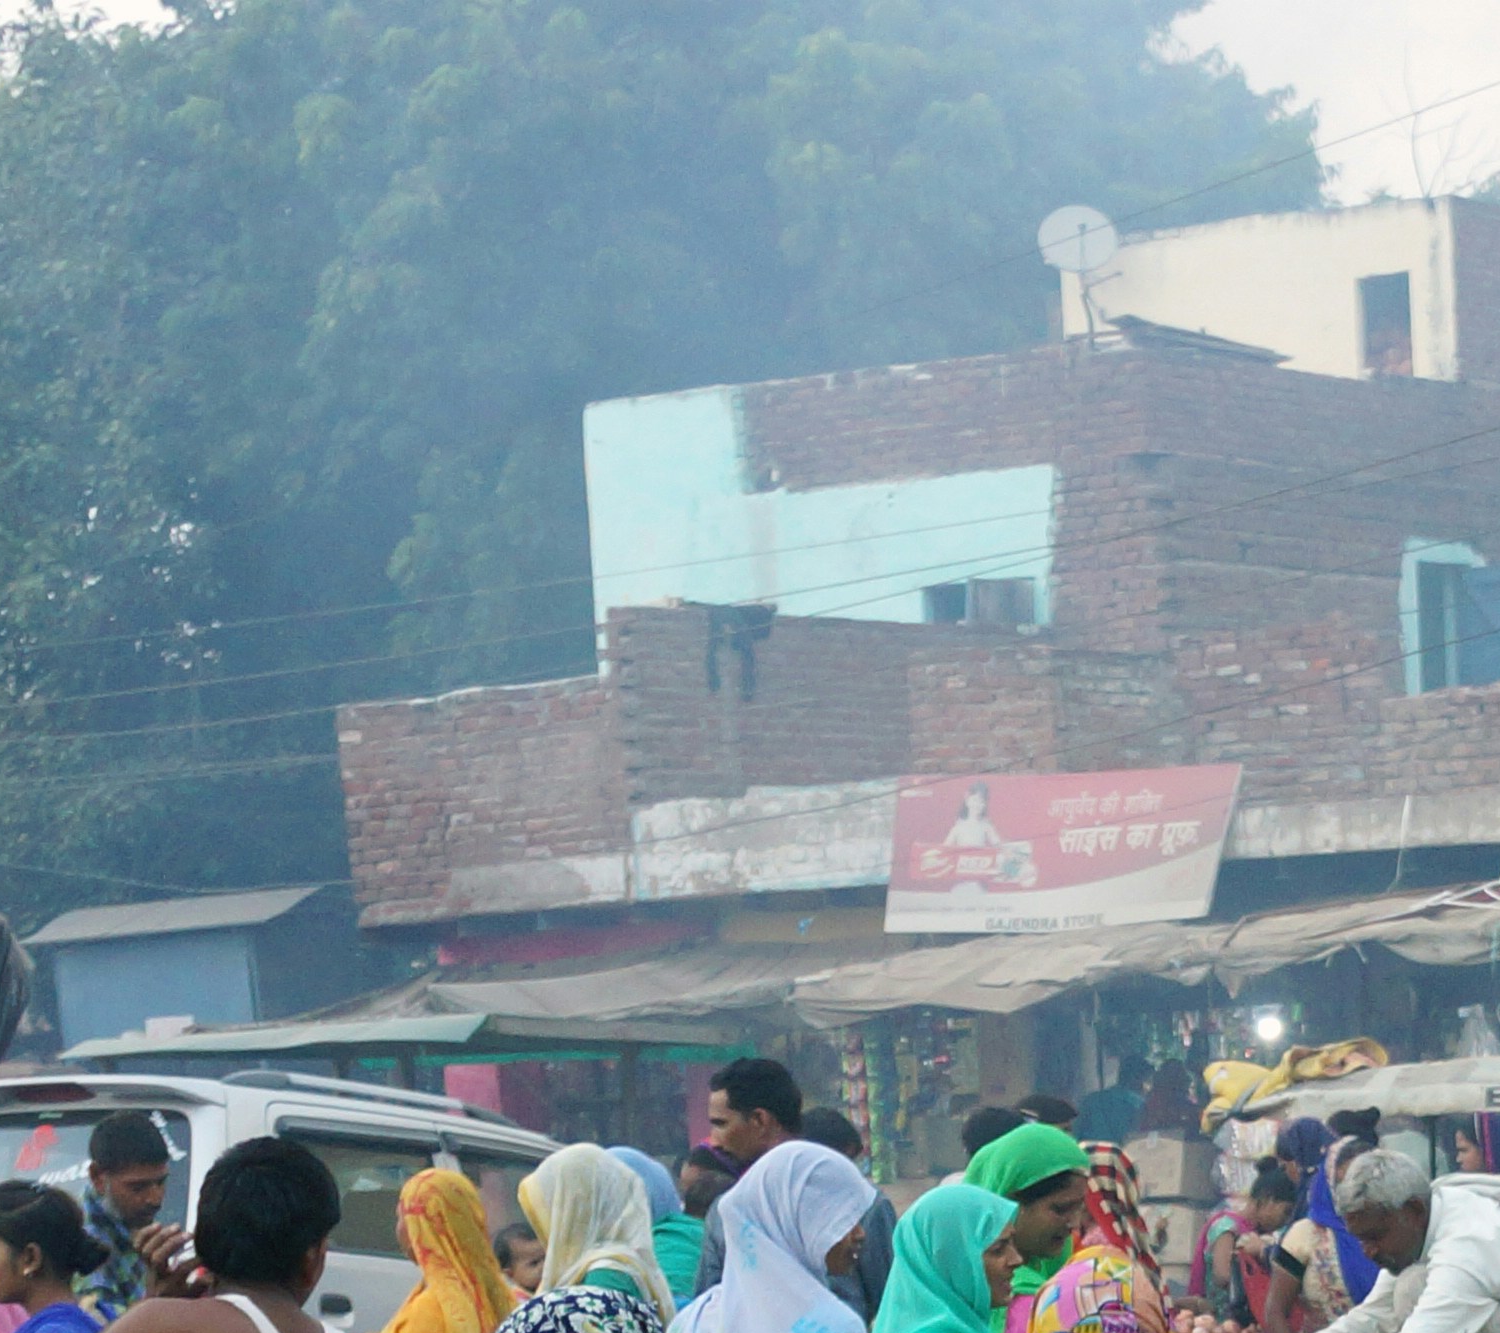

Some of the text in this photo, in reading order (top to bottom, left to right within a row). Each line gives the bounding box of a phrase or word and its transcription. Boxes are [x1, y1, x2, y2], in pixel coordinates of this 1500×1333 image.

[1099, 790, 1121, 816] की
[1059, 819, 1121, 857] साइंस
[1126, 823, 1158, 850] का
[985, 915, 1059, 932] GAJENDRA
